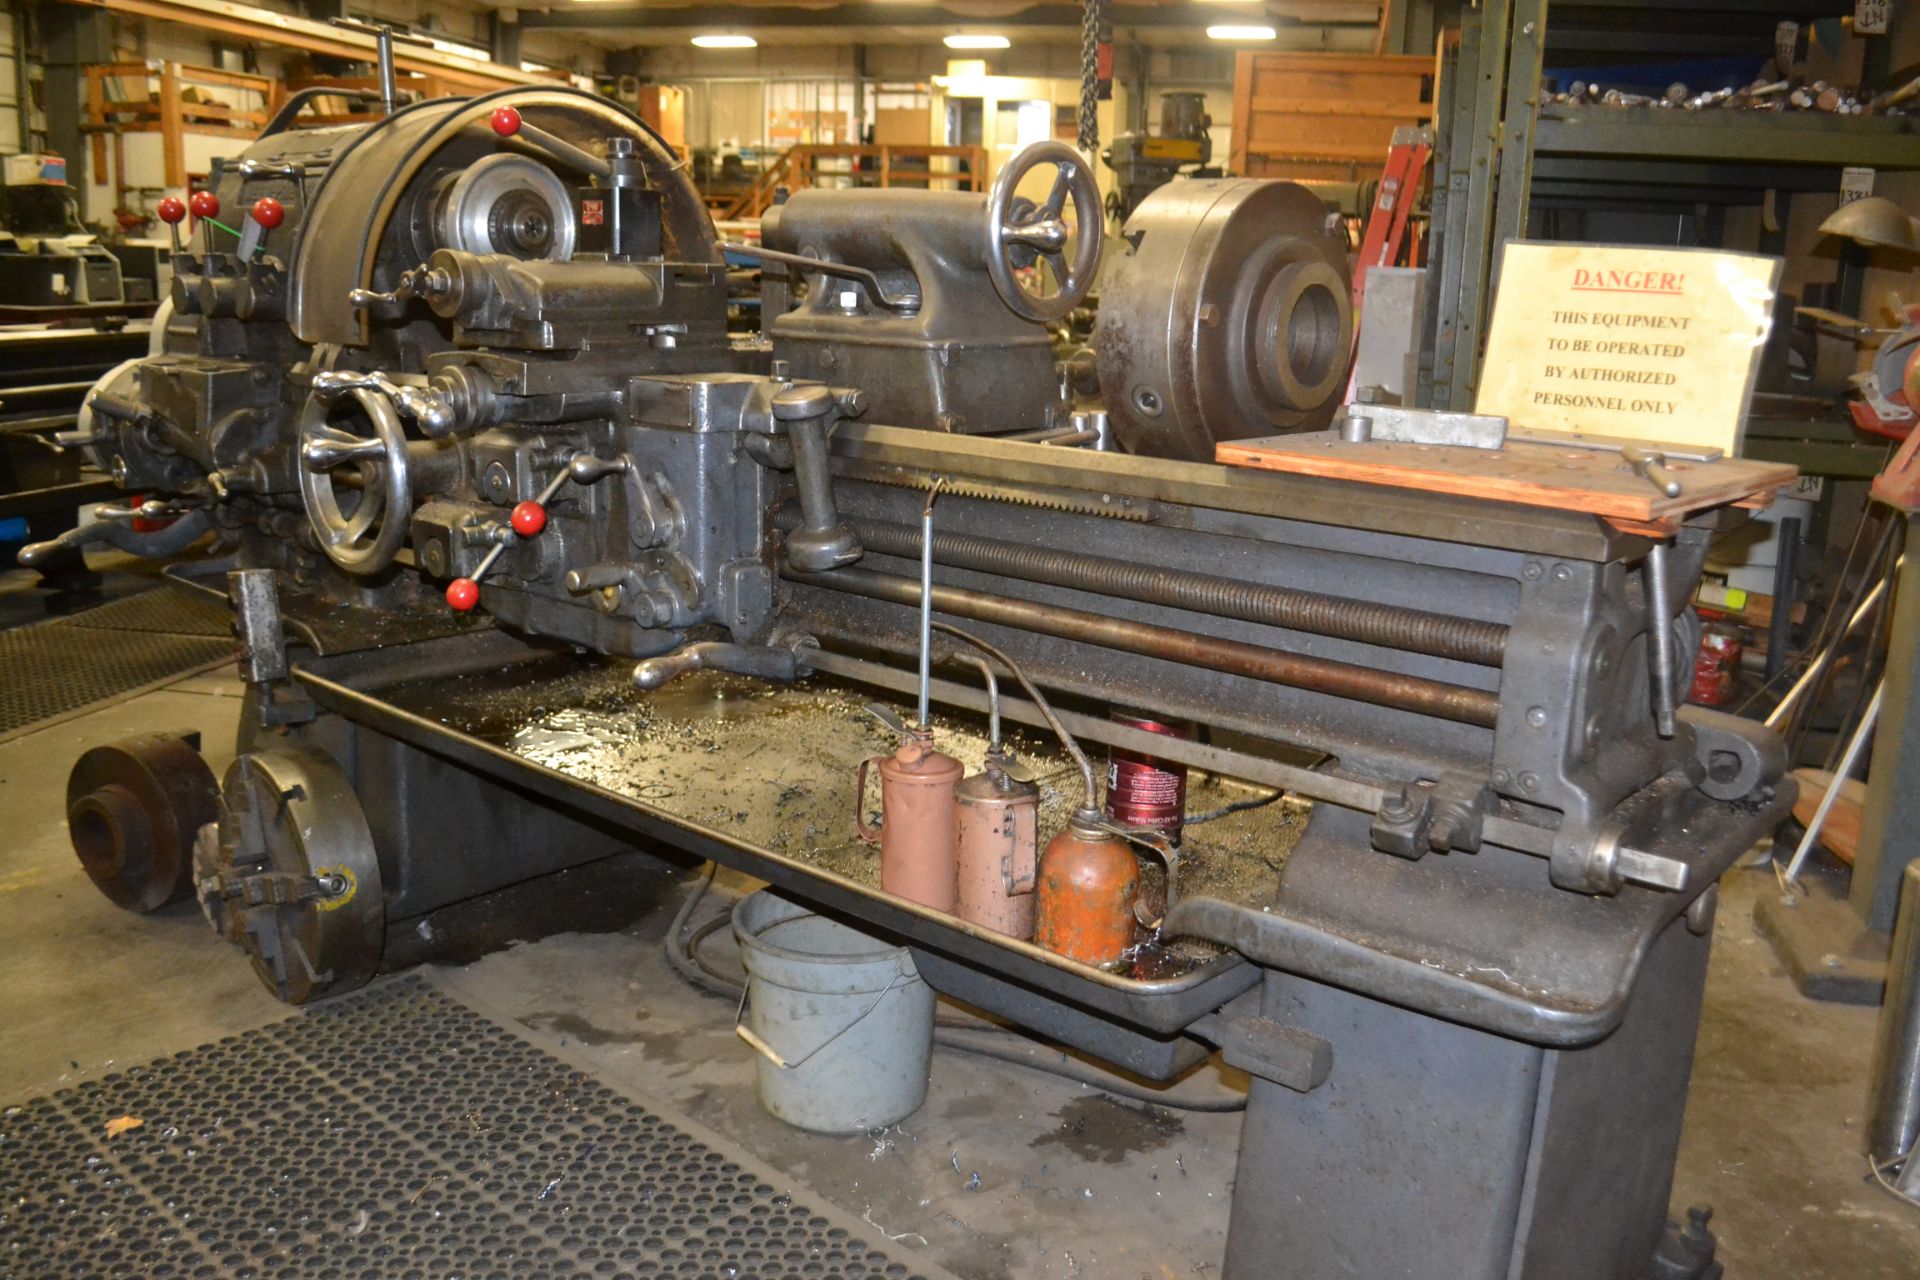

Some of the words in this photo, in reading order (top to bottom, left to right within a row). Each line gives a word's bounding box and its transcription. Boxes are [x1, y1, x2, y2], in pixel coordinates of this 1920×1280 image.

[1573, 269, 1685, 292] DANGER!
[1552, 311, 1588, 325] THIS
[1592, 312, 1692, 330] EQUIPMENT
[1548, 337, 1568, 350] TO
[1573, 339, 1593, 352] BE
[1596, 341, 1686, 358] OPERATED
[1544, 365, 1566, 378] BY
[1569, 367, 1677, 385] AUTHORIZED
[1534, 391, 1626, 410] PERSONNEL
[1631, 399, 1678, 415] ONLY
